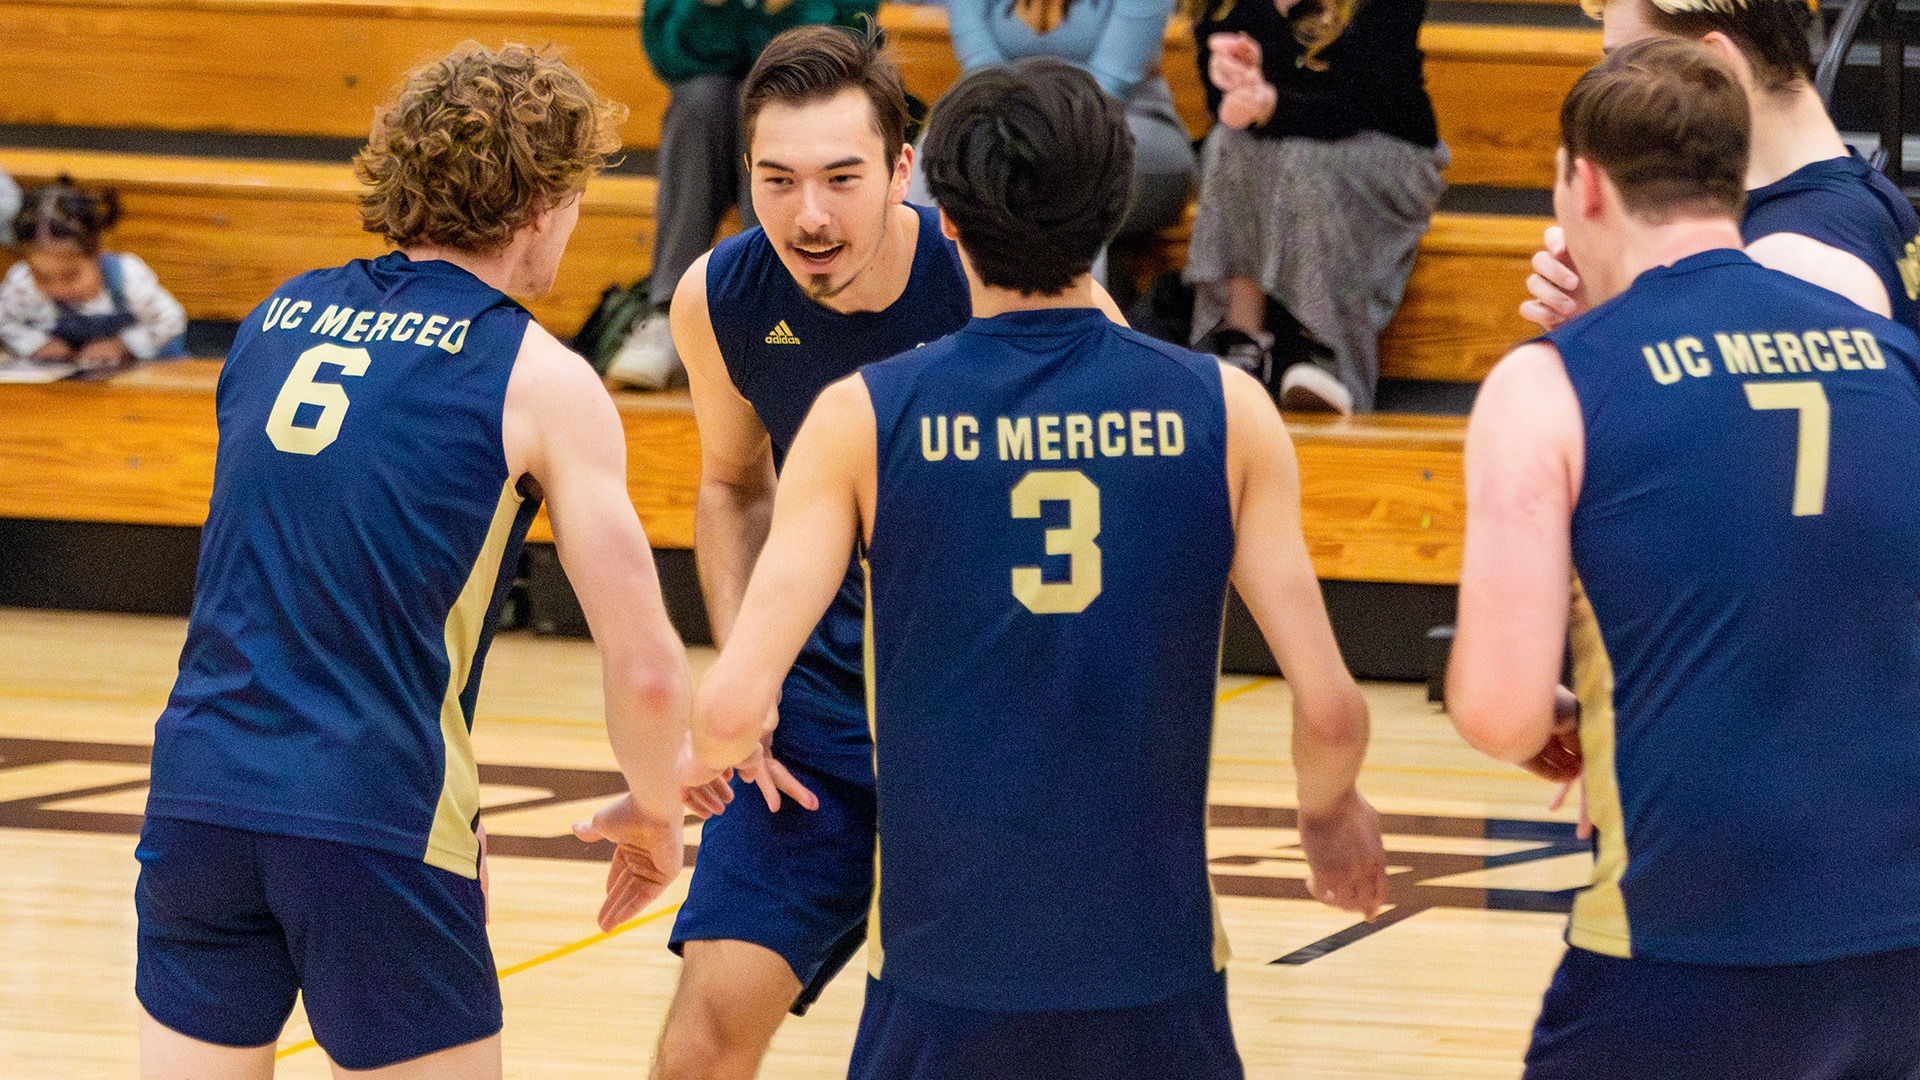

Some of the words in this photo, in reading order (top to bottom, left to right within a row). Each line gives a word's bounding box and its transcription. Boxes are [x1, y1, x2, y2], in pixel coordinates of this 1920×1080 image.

[262, 297, 312, 332] UC
[310, 304, 471, 355] MERCED
[764, 334, 801, 345] adidas
[1642, 336, 1712, 385] UC
[1713, 330, 1887, 374] MERCED
[265, 342, 372, 456] 6
[921, 415, 979, 461] UC
[997, 410, 1185, 461] MERCED
[1743, 381, 1830, 517] 7
[1011, 470, 1102, 614] 3
